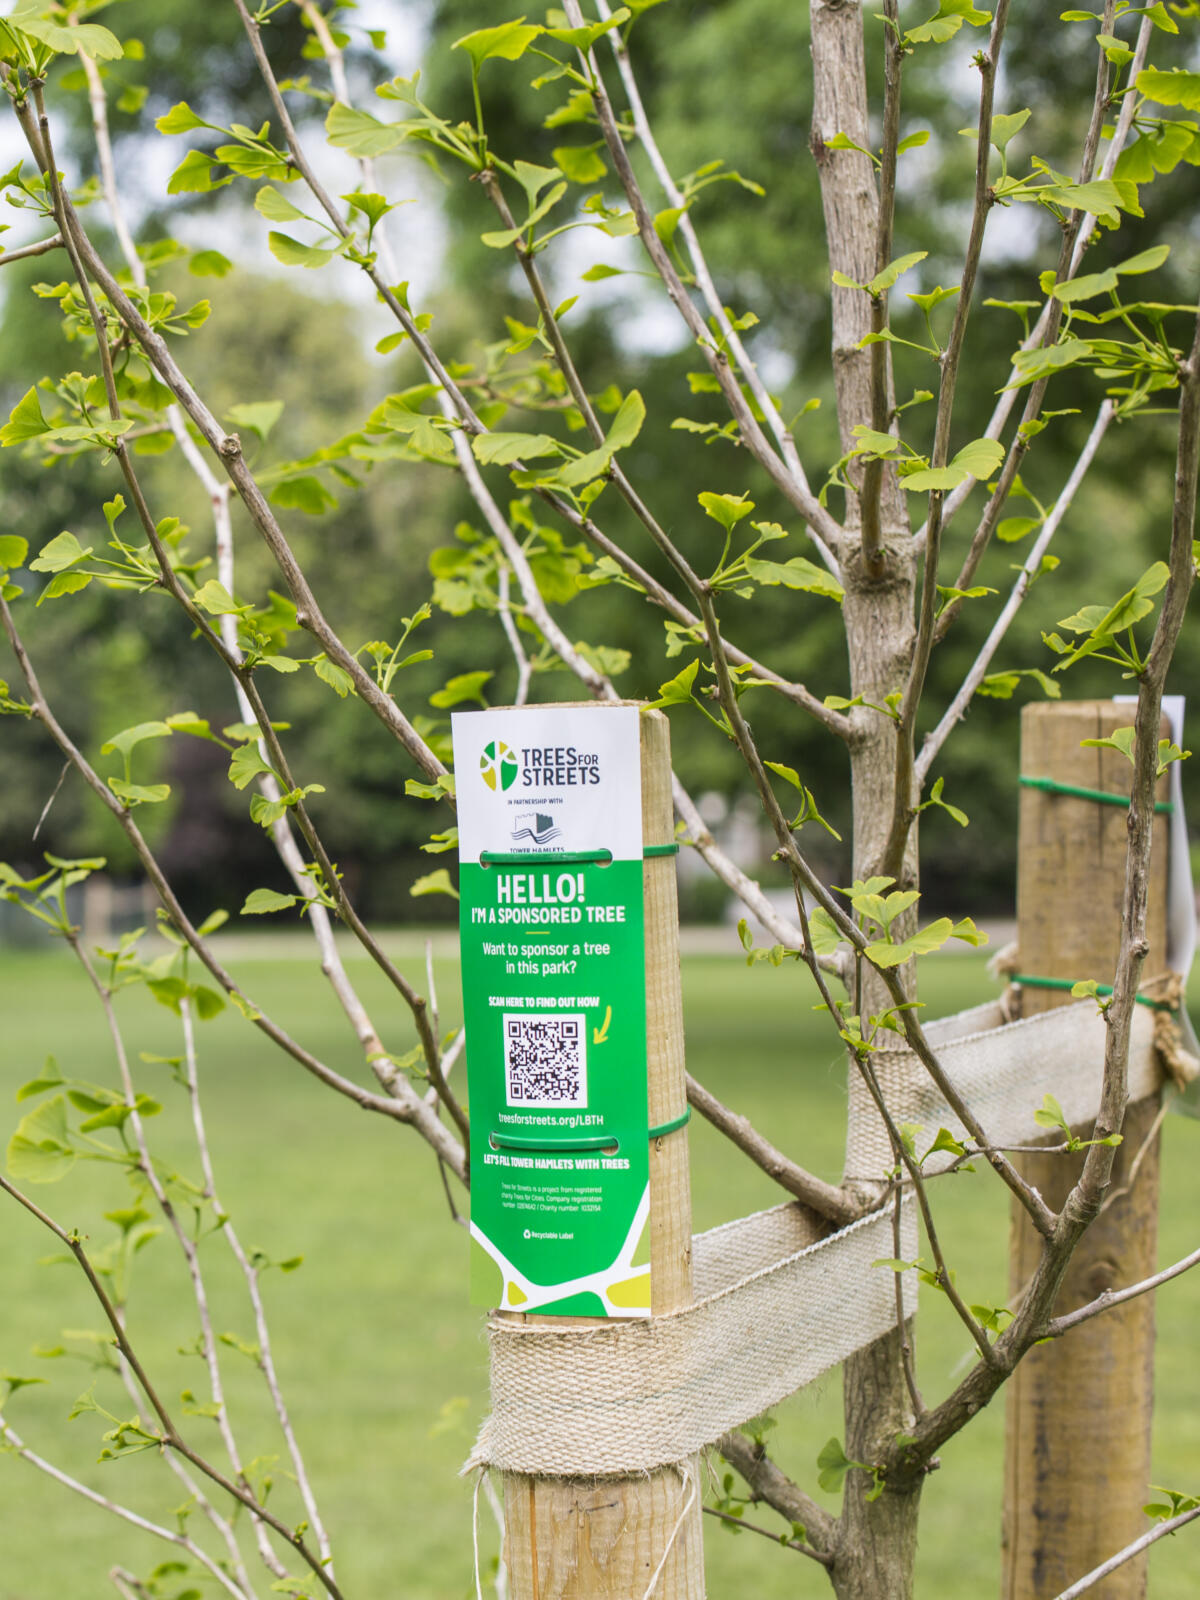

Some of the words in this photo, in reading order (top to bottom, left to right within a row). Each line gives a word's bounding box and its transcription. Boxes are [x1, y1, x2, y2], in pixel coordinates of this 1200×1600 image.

[522, 747, 577, 766] TREES
[578, 754, 599, 765] FOR
[522, 766, 600, 786] STREETS
[497, 873, 585, 904] HELLO!
[488, 907, 496, 923] A
[498, 907, 582, 924] SPONSORED
[585, 906, 626, 922] TREE
[482, 942, 506, 956] Want
[507, 943, 518, 956] to
[520, 944, 569, 959] sponsor
[572, 944, 580, 955] a
[583, 942, 610, 955] tree
[506, 960, 515, 974] in
[517, 960, 539, 974] this
[542, 960, 577, 977] park?
[488, 996, 505, 1007] SCAN
[505, 996, 524, 1007] HERE
[525, 996, 535, 1007] TO
[536, 997, 557, 1008] FIND
[557, 997, 576, 1007] OUT
[576, 996, 600, 1007] HOW
[498, 1112, 604, 1128] treesforstreets.org/LBTH
[499, 1155, 510, 1167] FILL
[511, 1156, 534, 1168] TOWER
[535, 1158, 574, 1169] HAMLETS
[575, 1159, 600, 1170] WITH
[601, 1158, 630, 1169] TREES
[542, 1186, 560, 1194] project
[560, 1185, 573, 1193] from
[574, 1186, 602, 1194] registered
[571, 1195, 603, 1204] registration
[531, 1231, 558, 1239] Recyclable
